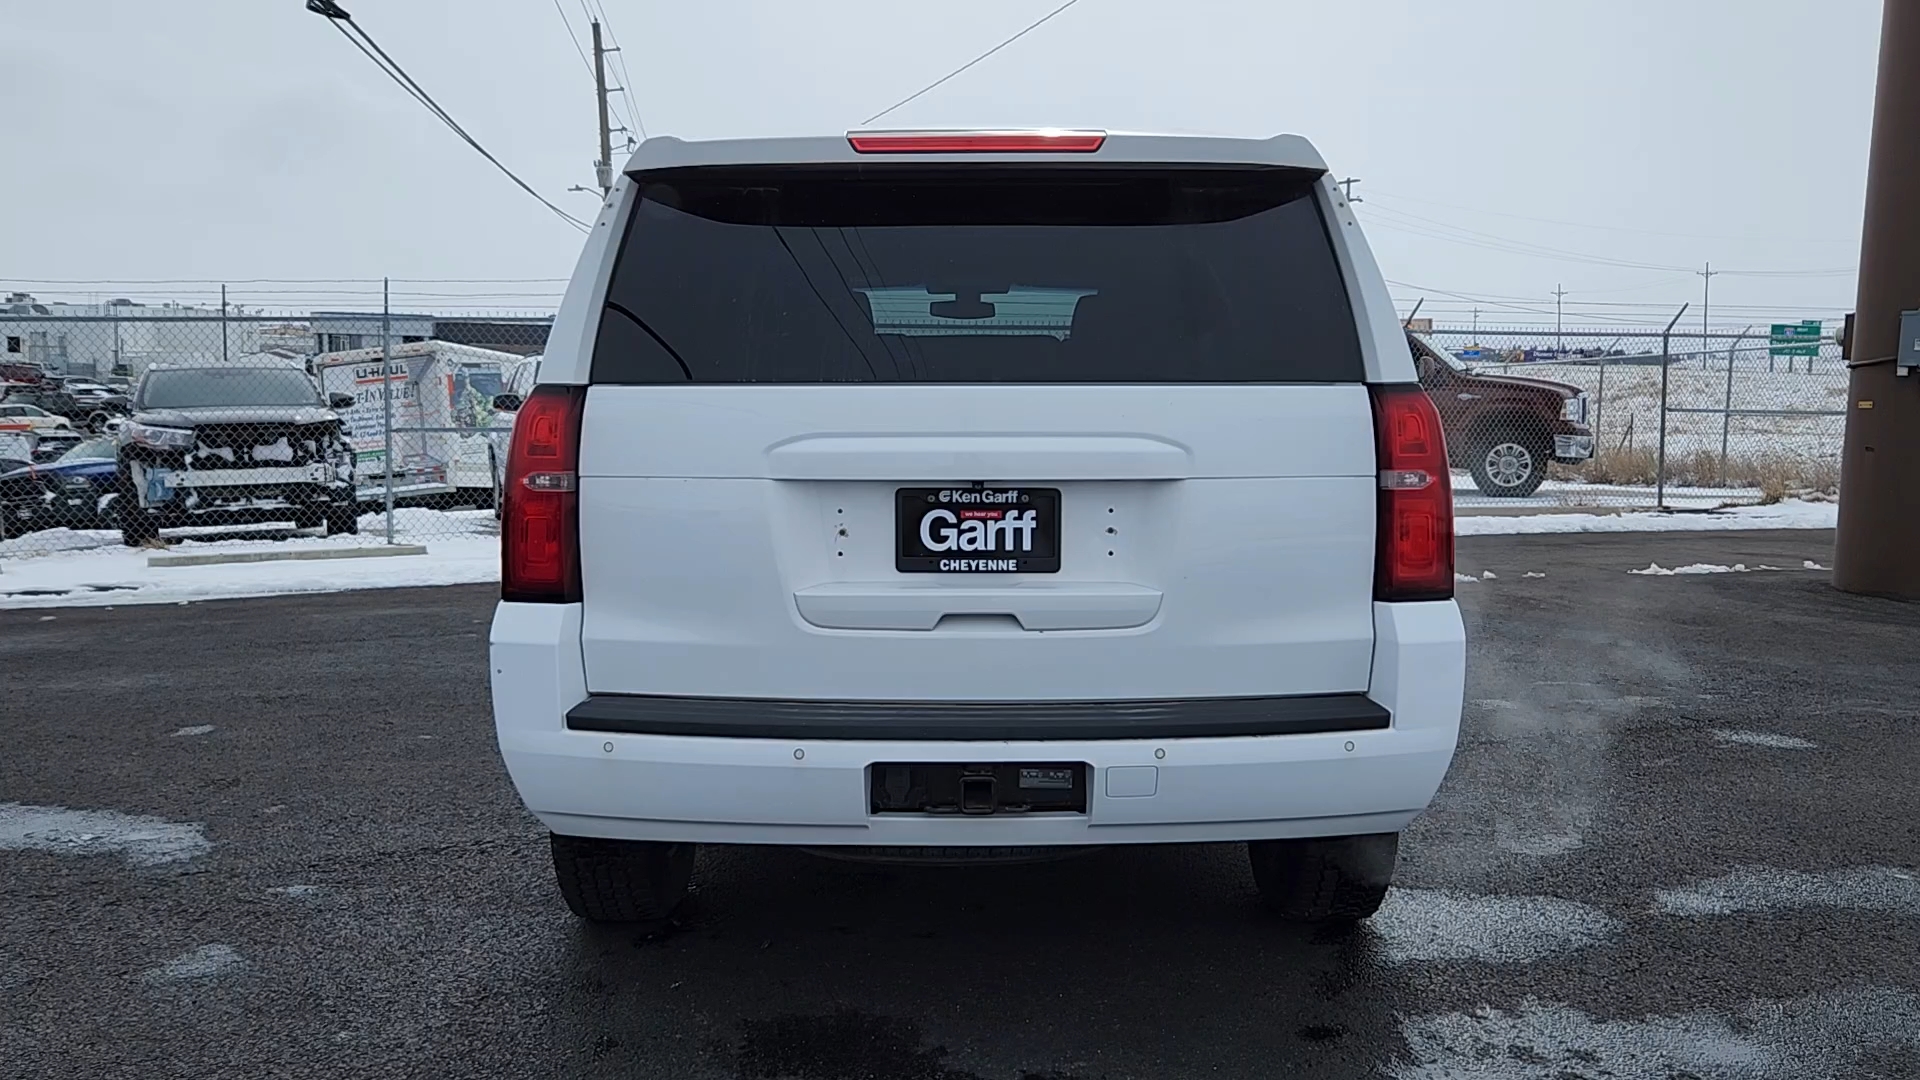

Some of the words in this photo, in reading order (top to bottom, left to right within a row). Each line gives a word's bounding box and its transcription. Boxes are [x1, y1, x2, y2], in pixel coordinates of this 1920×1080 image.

[377, 383, 415, 401] VLUE!
[952, 490, 980, 503] Ken
[982, 490, 1018, 503] Garff
[920, 509, 1037, 552] Garff
[940, 559, 1017, 571] CHEYENNE
